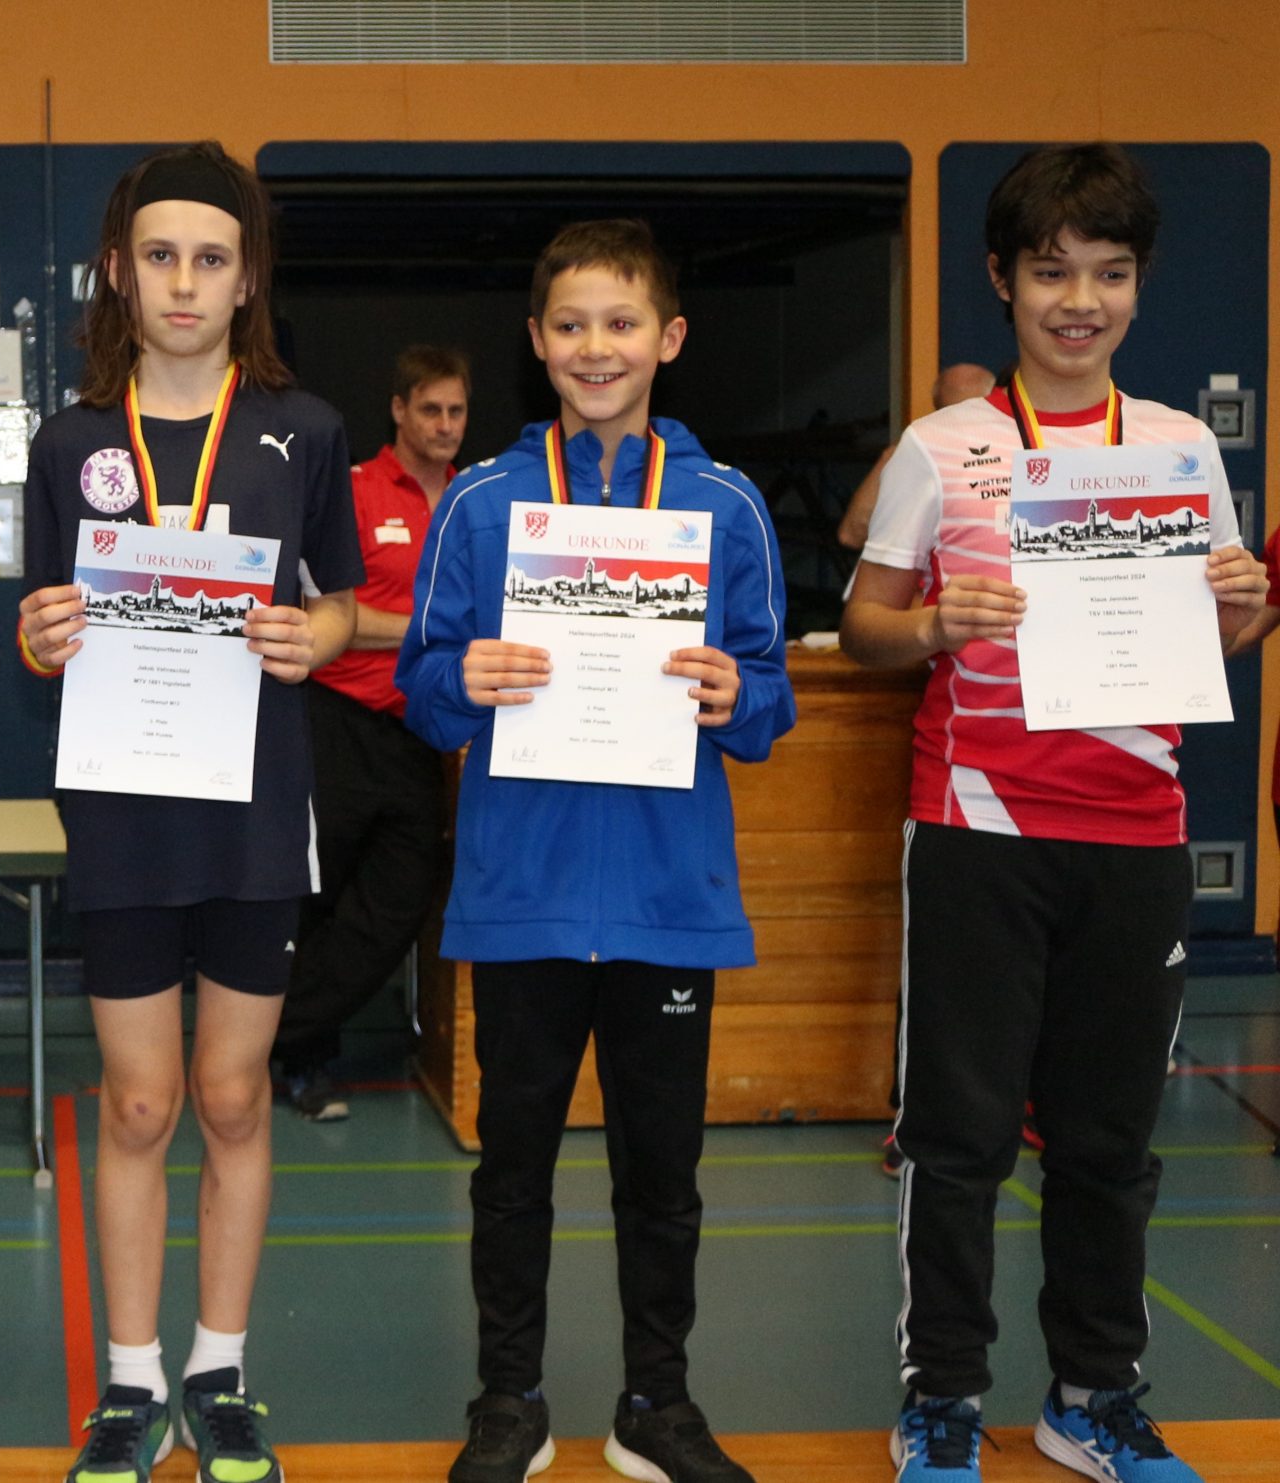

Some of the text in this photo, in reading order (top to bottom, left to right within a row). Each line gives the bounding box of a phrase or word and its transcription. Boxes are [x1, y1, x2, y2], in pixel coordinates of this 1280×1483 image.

[963, 456, 1002, 468] erima
[1029, 461, 1048, 473] TSV
[1070, 475, 1151, 491] URKUNDE
[85, 486, 140, 511] INGOLSTAD
[526, 512, 548, 525] TSV
[95, 530, 116, 542] TSV
[568, 535, 650, 552] URKUNDE
[135, 552, 218, 572] URKUNDE
[1080, 574, 1128, 584] Hallensportfest
[662, 1003, 696, 1014] erima
